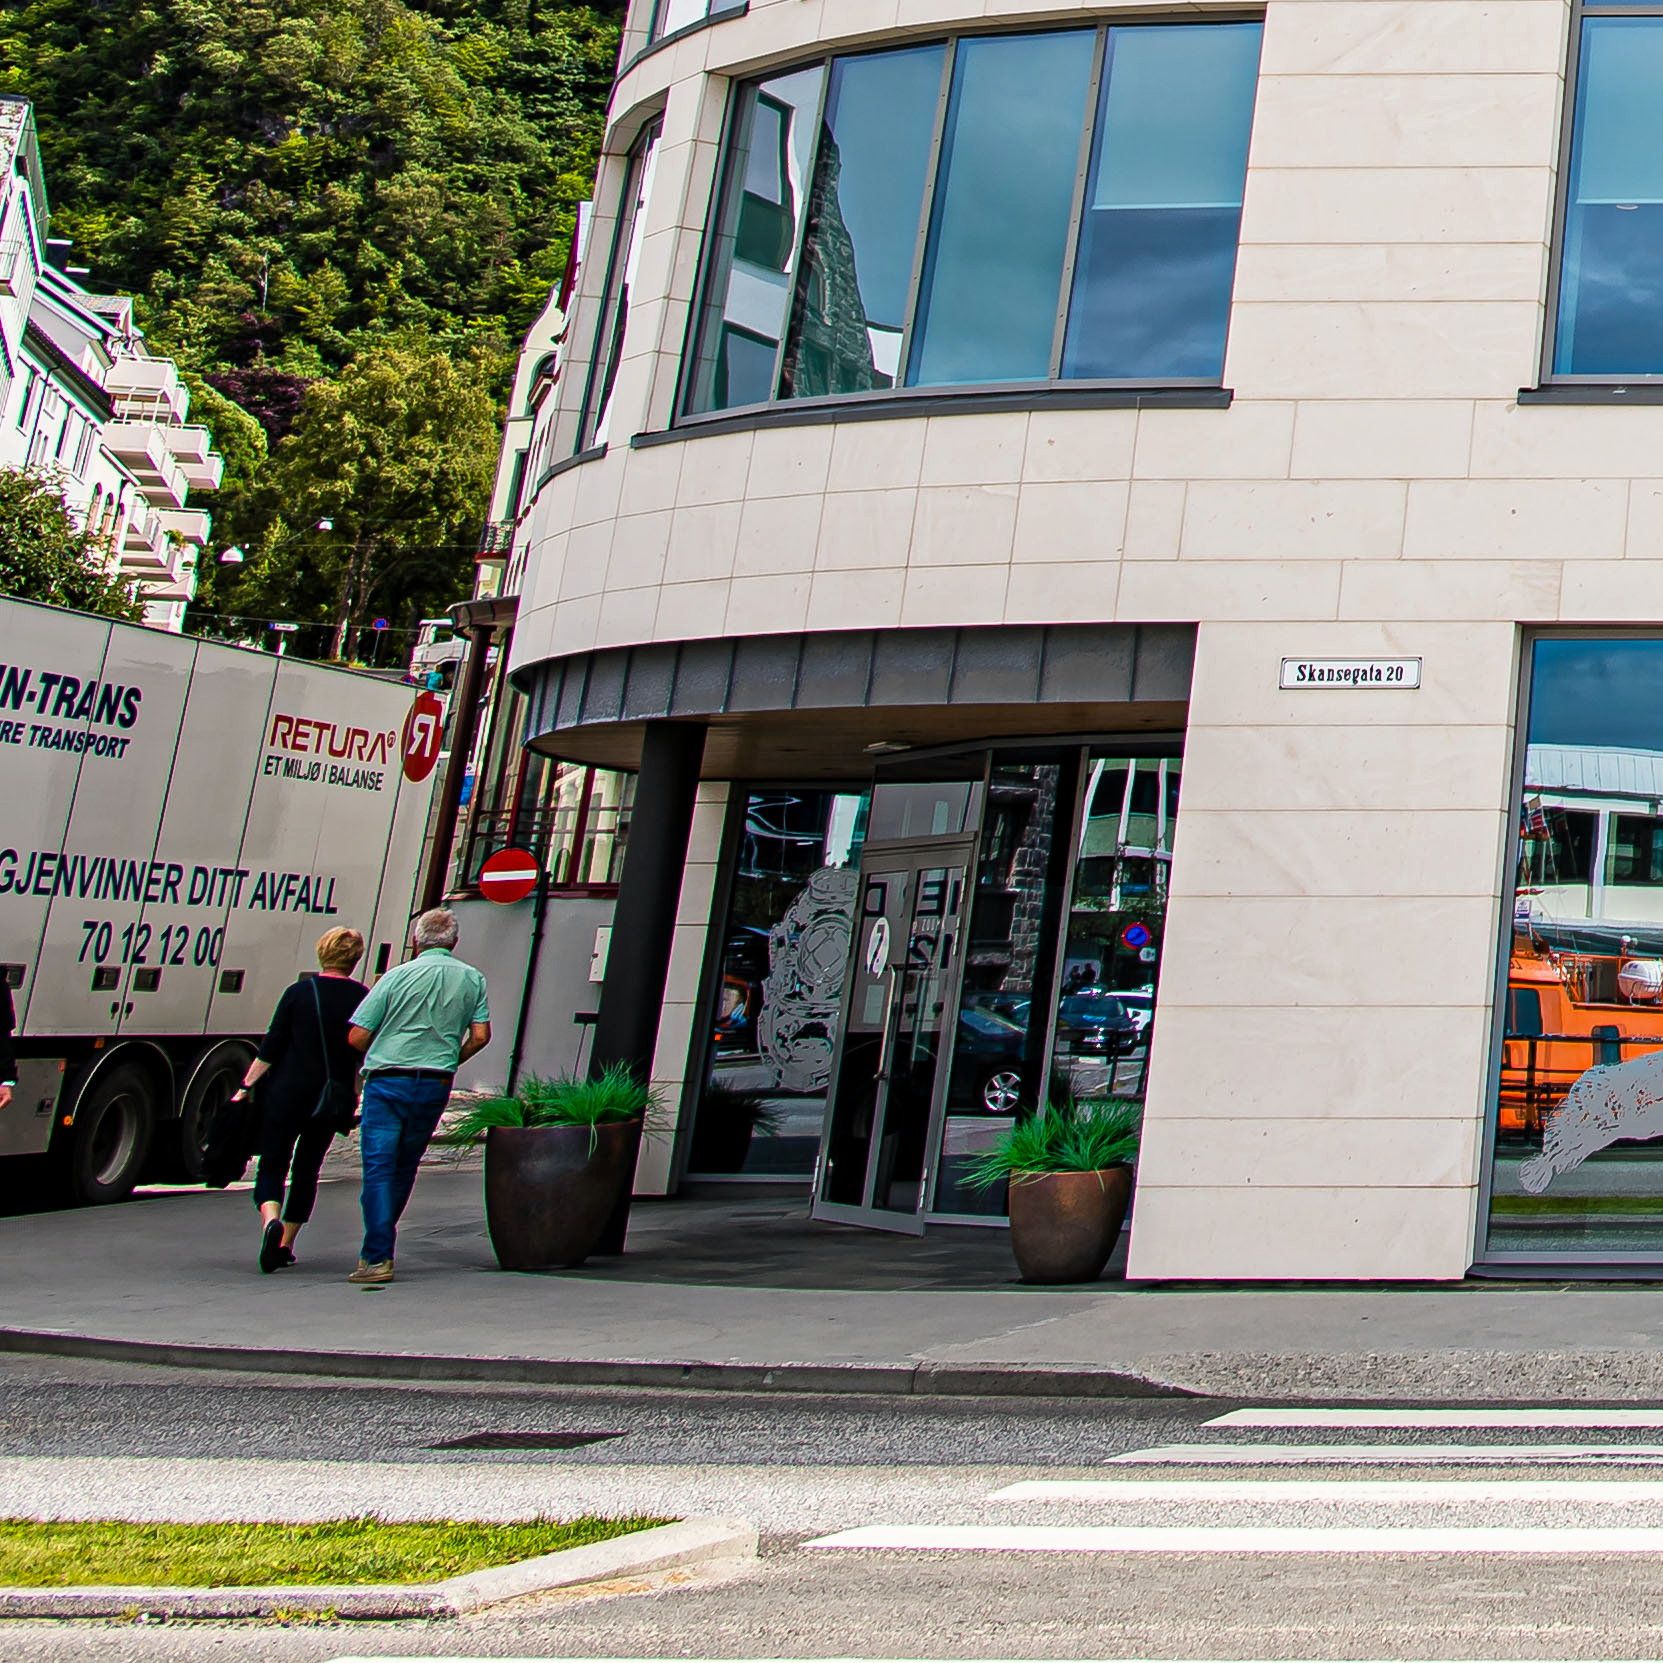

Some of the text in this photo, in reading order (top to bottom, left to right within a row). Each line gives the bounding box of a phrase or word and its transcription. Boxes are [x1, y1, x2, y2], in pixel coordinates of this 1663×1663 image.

[1296, 663, 1404, 686] Skansegata 20
[0, 664, 142, 729] N-TRANS
[0, 720, 131, 759] RE TRANSPORT
[263, 754, 385, 791] ET MILJØ I BALANSE
[0, 848, 338, 915] GJENVINNER DITT AVFALL
[78, 920, 225, 967] 70 12 12 00
